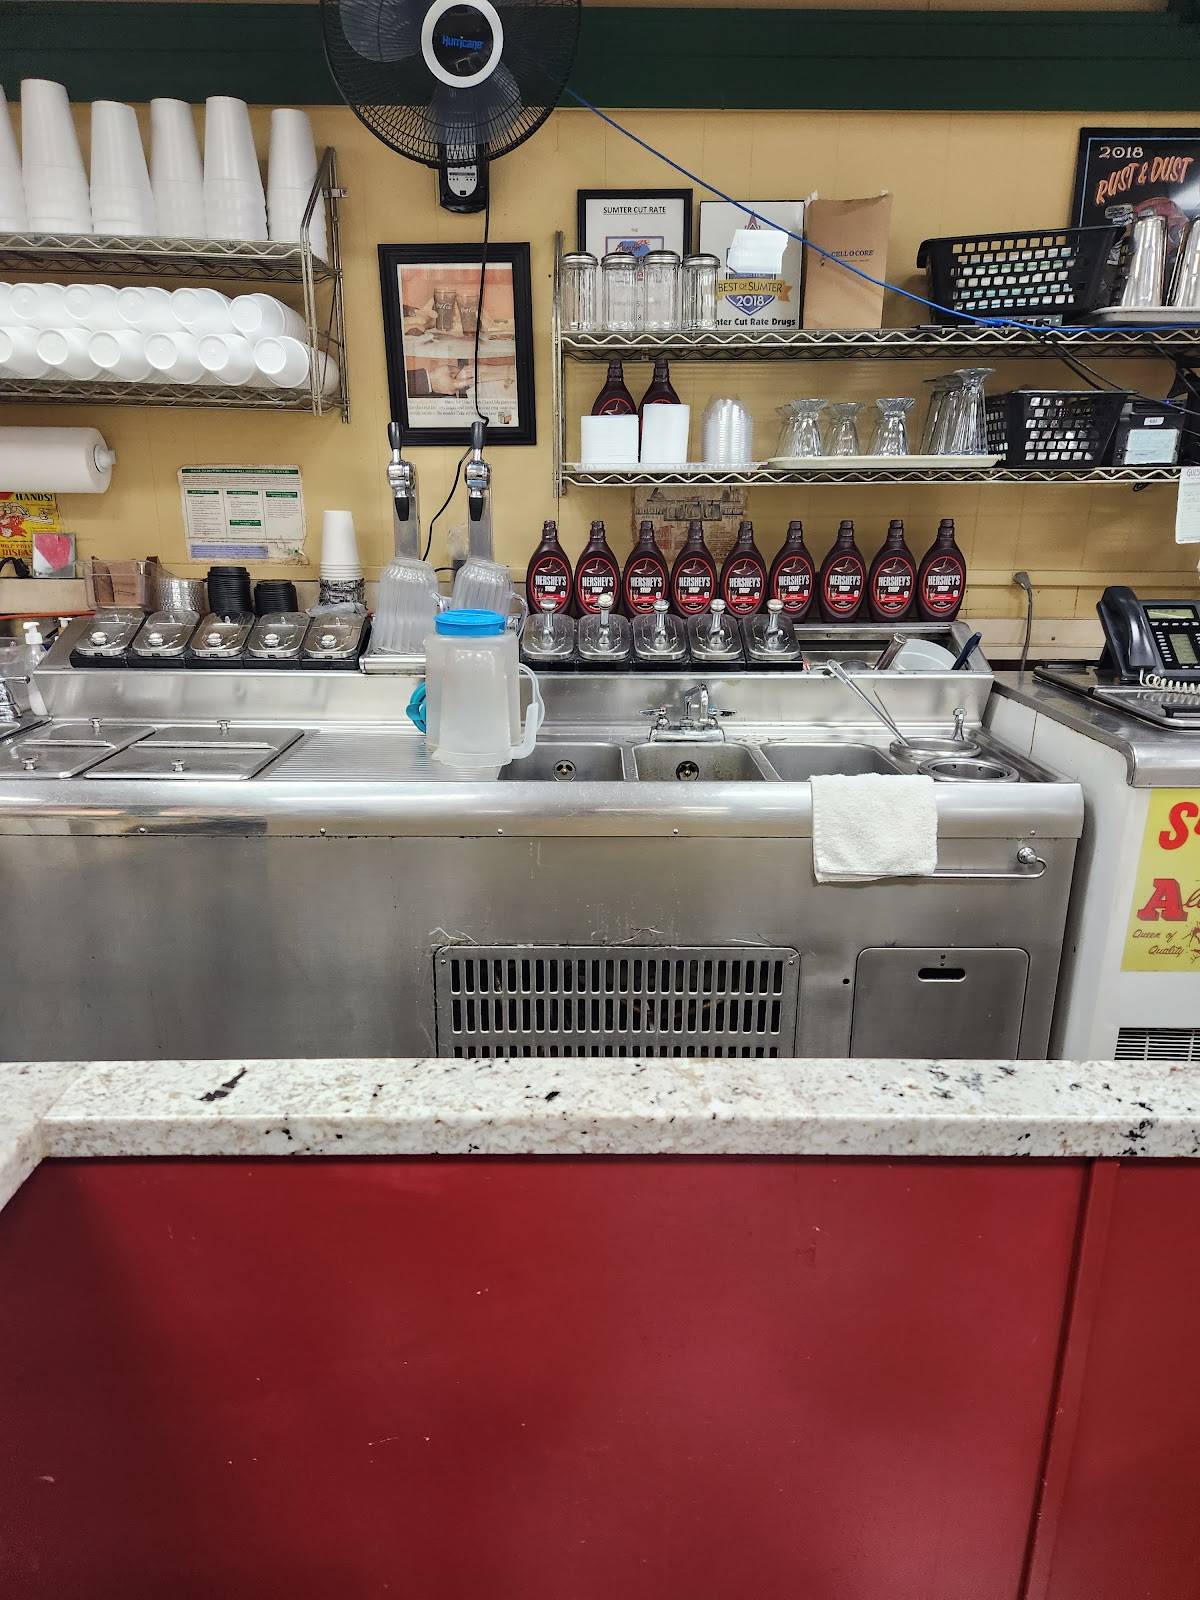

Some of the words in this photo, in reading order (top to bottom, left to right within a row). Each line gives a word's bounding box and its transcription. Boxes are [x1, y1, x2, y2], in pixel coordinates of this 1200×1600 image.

[442, 35, 485, 50] Hurricane
[1098, 146, 1144, 159] 2018
[1095, 162, 1140, 205] RUST
[1137, 161, 1149, 185] &
[1150, 155, 1194, 184] DUST
[603, 206, 632, 214] SUMTER
[633, 206, 648, 214] CUT
[718, 282, 738, 293] BEST
[748, 281, 783, 293] SUMTER
[736, 295, 765, 307] 2018
[734, 318, 748, 326] Cut
[750, 318, 769, 326] Rate
[771, 318, 796, 328] Drugs
[535, 575, 567, 587] HERSHEY'S
[582, 576, 614, 587] HERSHEY'S
[630, 577, 662, 587] HERSHEY'S
[679, 577, 711, 587] HERSHEY'S
[729, 577, 761, 588] HERSHEY'S
[778, 575, 810, 586] HERSHEY'S
[829, 575, 861, 586] HERSHEY'S
[878, 576, 911, 587] HERSHEY'S
[927, 575, 960, 586] HERSHEY'S
[1158, 801, 1200, 851] S
[1132, 929, 1161, 939] Queen
[1165, 930, 1178, 944] of
[1148, 945, 1185, 958] Quality
